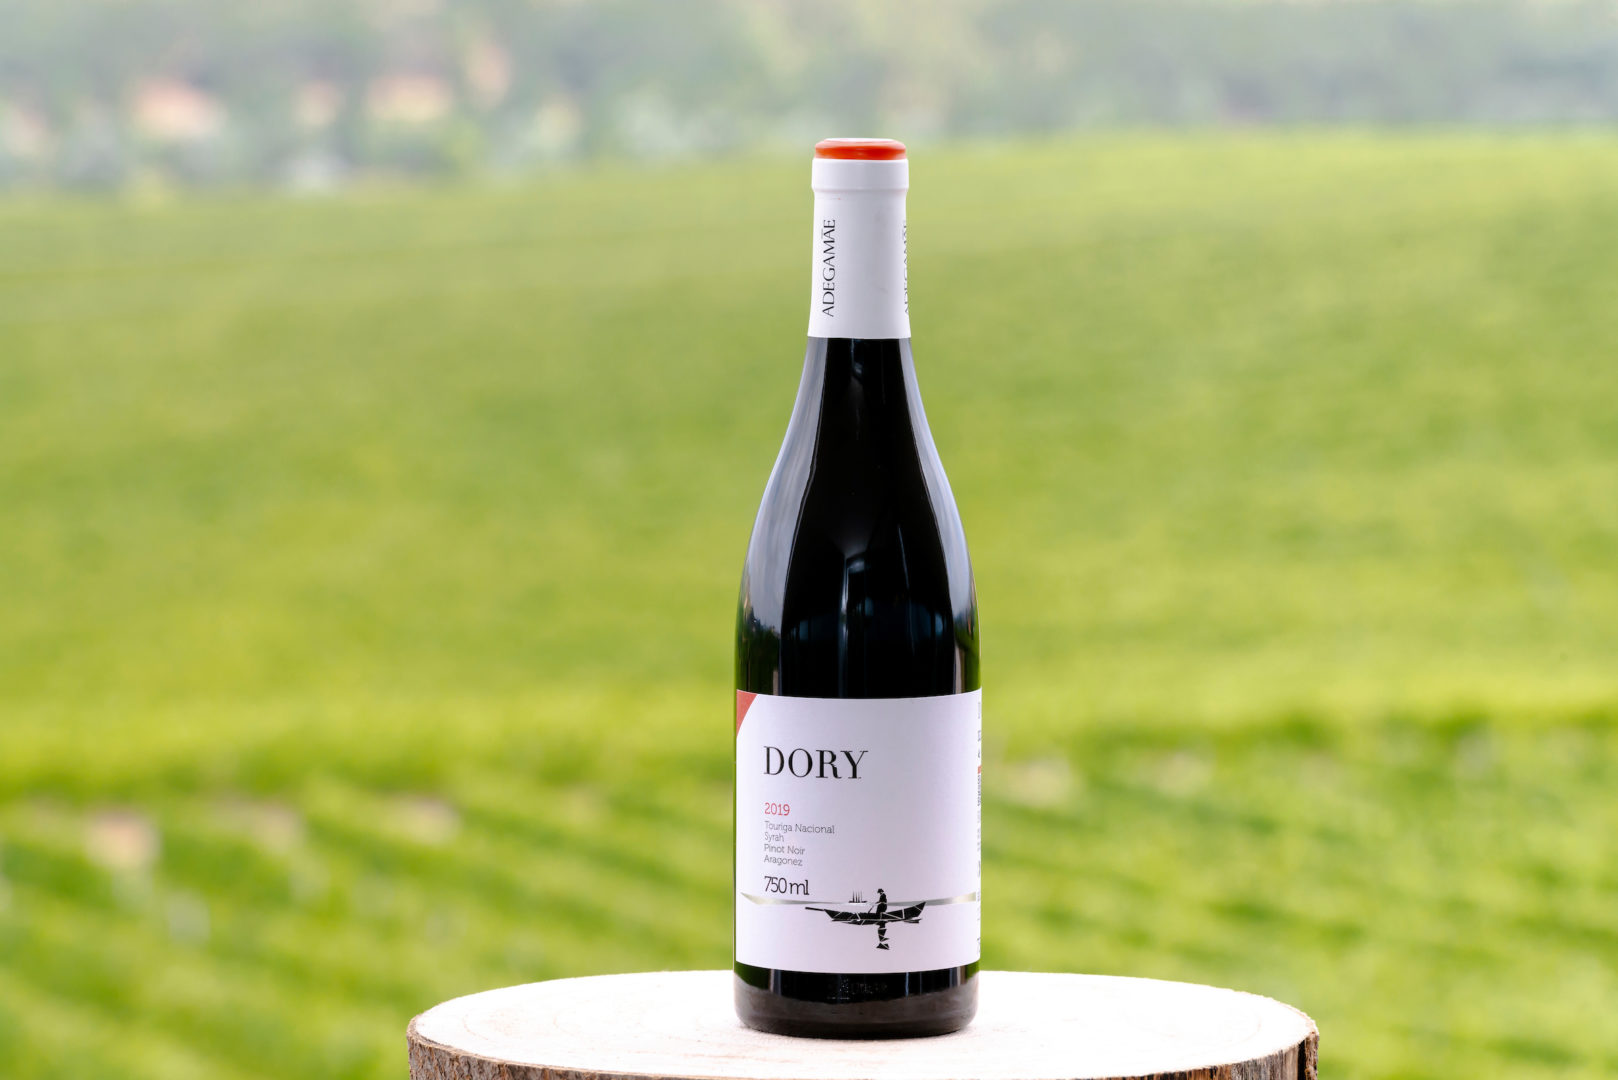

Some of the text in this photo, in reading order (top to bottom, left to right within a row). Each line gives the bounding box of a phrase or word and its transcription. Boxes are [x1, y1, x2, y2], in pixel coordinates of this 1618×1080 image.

[764, 746, 868, 779] DORY
[764, 802, 790, 816] 2019
[765, 820, 835, 834] Touriga Nacional
[764, 831, 784, 842] Syrah
[764, 843, 805, 855] Pinot Noir
[764, 855, 803, 866] Aragonez
[764, 875, 809, 895] 750 ml
